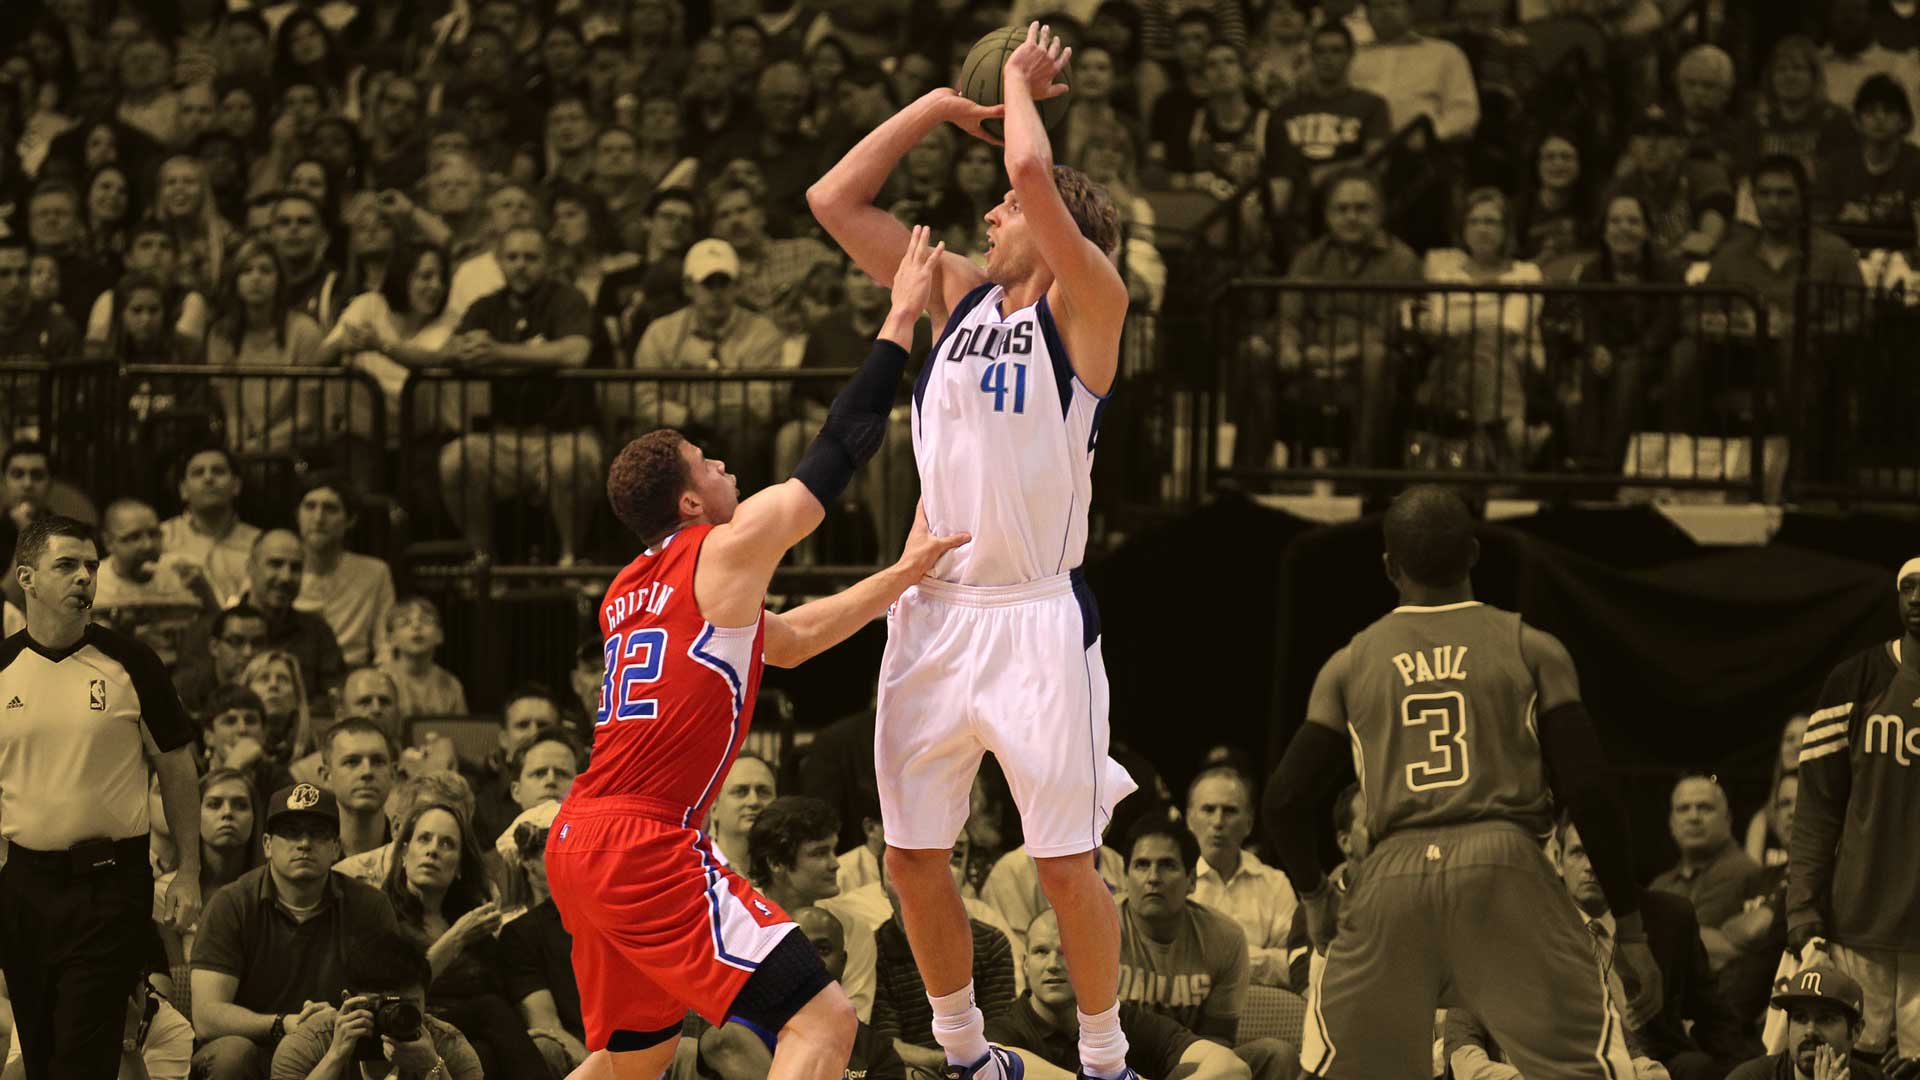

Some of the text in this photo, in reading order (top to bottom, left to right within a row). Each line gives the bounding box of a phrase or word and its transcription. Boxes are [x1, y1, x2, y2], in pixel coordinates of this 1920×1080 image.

[980, 361, 1027, 415] 41
[595, 627, 669, 726] 32
[1391, 645, 1468, 687] PAUL
[1401, 690, 1470, 793] 3
